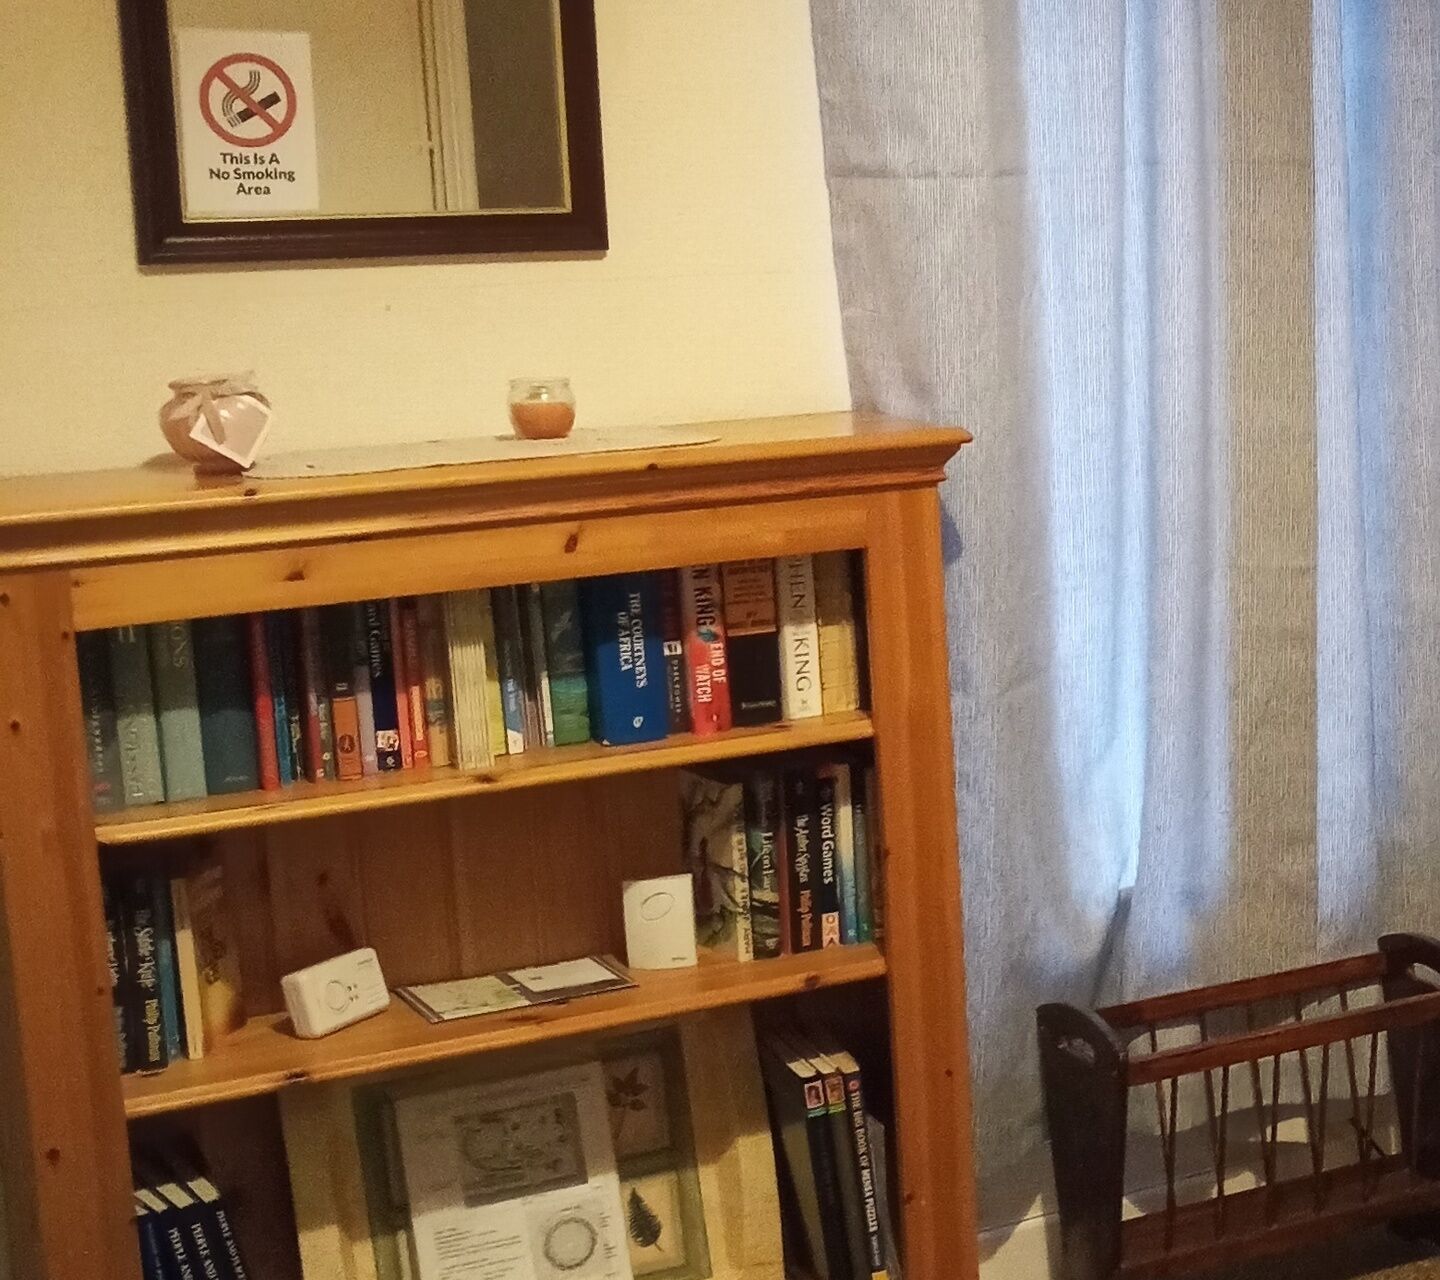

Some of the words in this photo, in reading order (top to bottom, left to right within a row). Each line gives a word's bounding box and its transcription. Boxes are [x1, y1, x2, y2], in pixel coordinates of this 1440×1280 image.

[220, 152, 250, 165] This
[253, 153, 266, 165] Is
[269, 153, 280, 165] A
[209, 169, 230, 181] No
[234, 168, 296, 182] Smoking
[236, 183, 271, 196] Area
[694, 586, 716, 626] KING
[619, 631, 633, 672] AFRICA
[632, 619, 648, 689] COURTNEYS
[708, 642, 725, 667] END
[794, 637, 812, 692] KING
[695, 662, 713, 703] WATCH
[712, 669, 726, 683] OF
[821, 804, 835, 839] Word
[822, 840, 835, 884] Games
[851, 1091, 861, 1110] THE
[853, 1110, 864, 1128] BIG
[855, 1128, 867, 1155] BOOK
[860, 1155, 870, 1167] OF
[865, 1198, 878, 1232] PUZZLES
